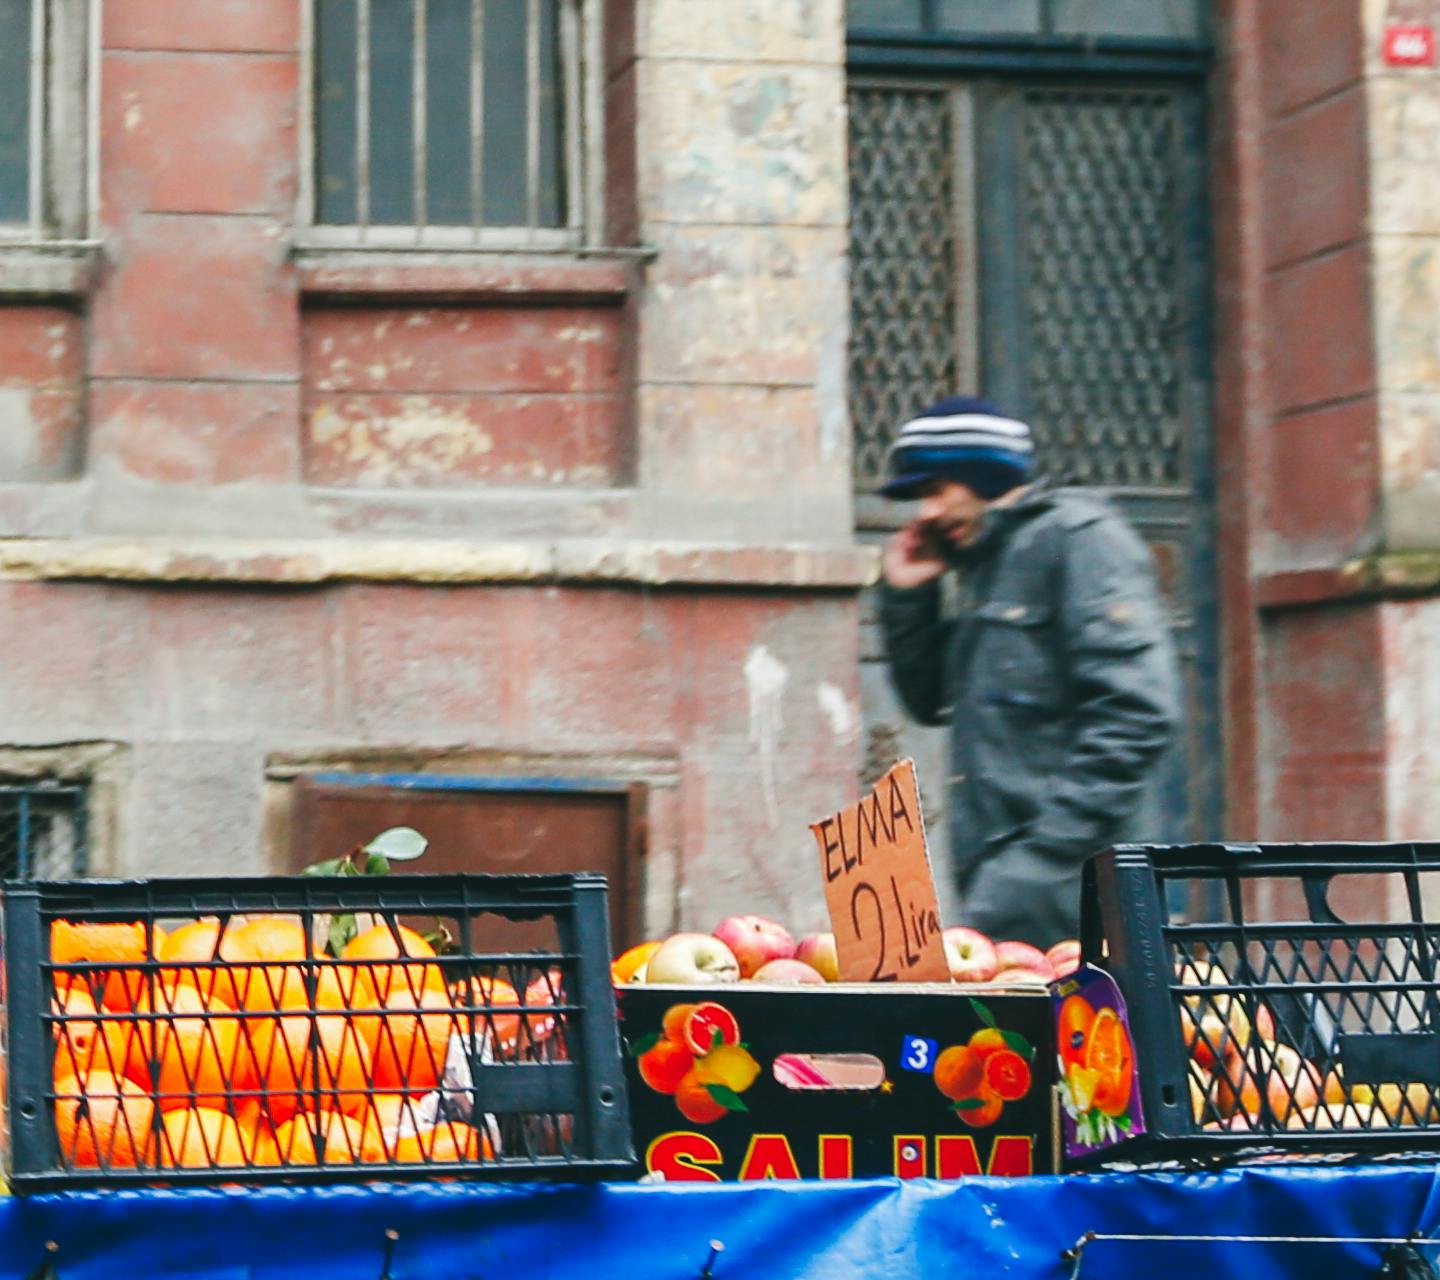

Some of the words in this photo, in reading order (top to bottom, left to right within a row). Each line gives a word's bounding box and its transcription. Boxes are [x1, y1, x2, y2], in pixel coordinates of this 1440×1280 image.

[820, 772, 913, 883] ELMA
[851, 881, 898, 983] 2
[906, 1037, 929, 1070] 3
